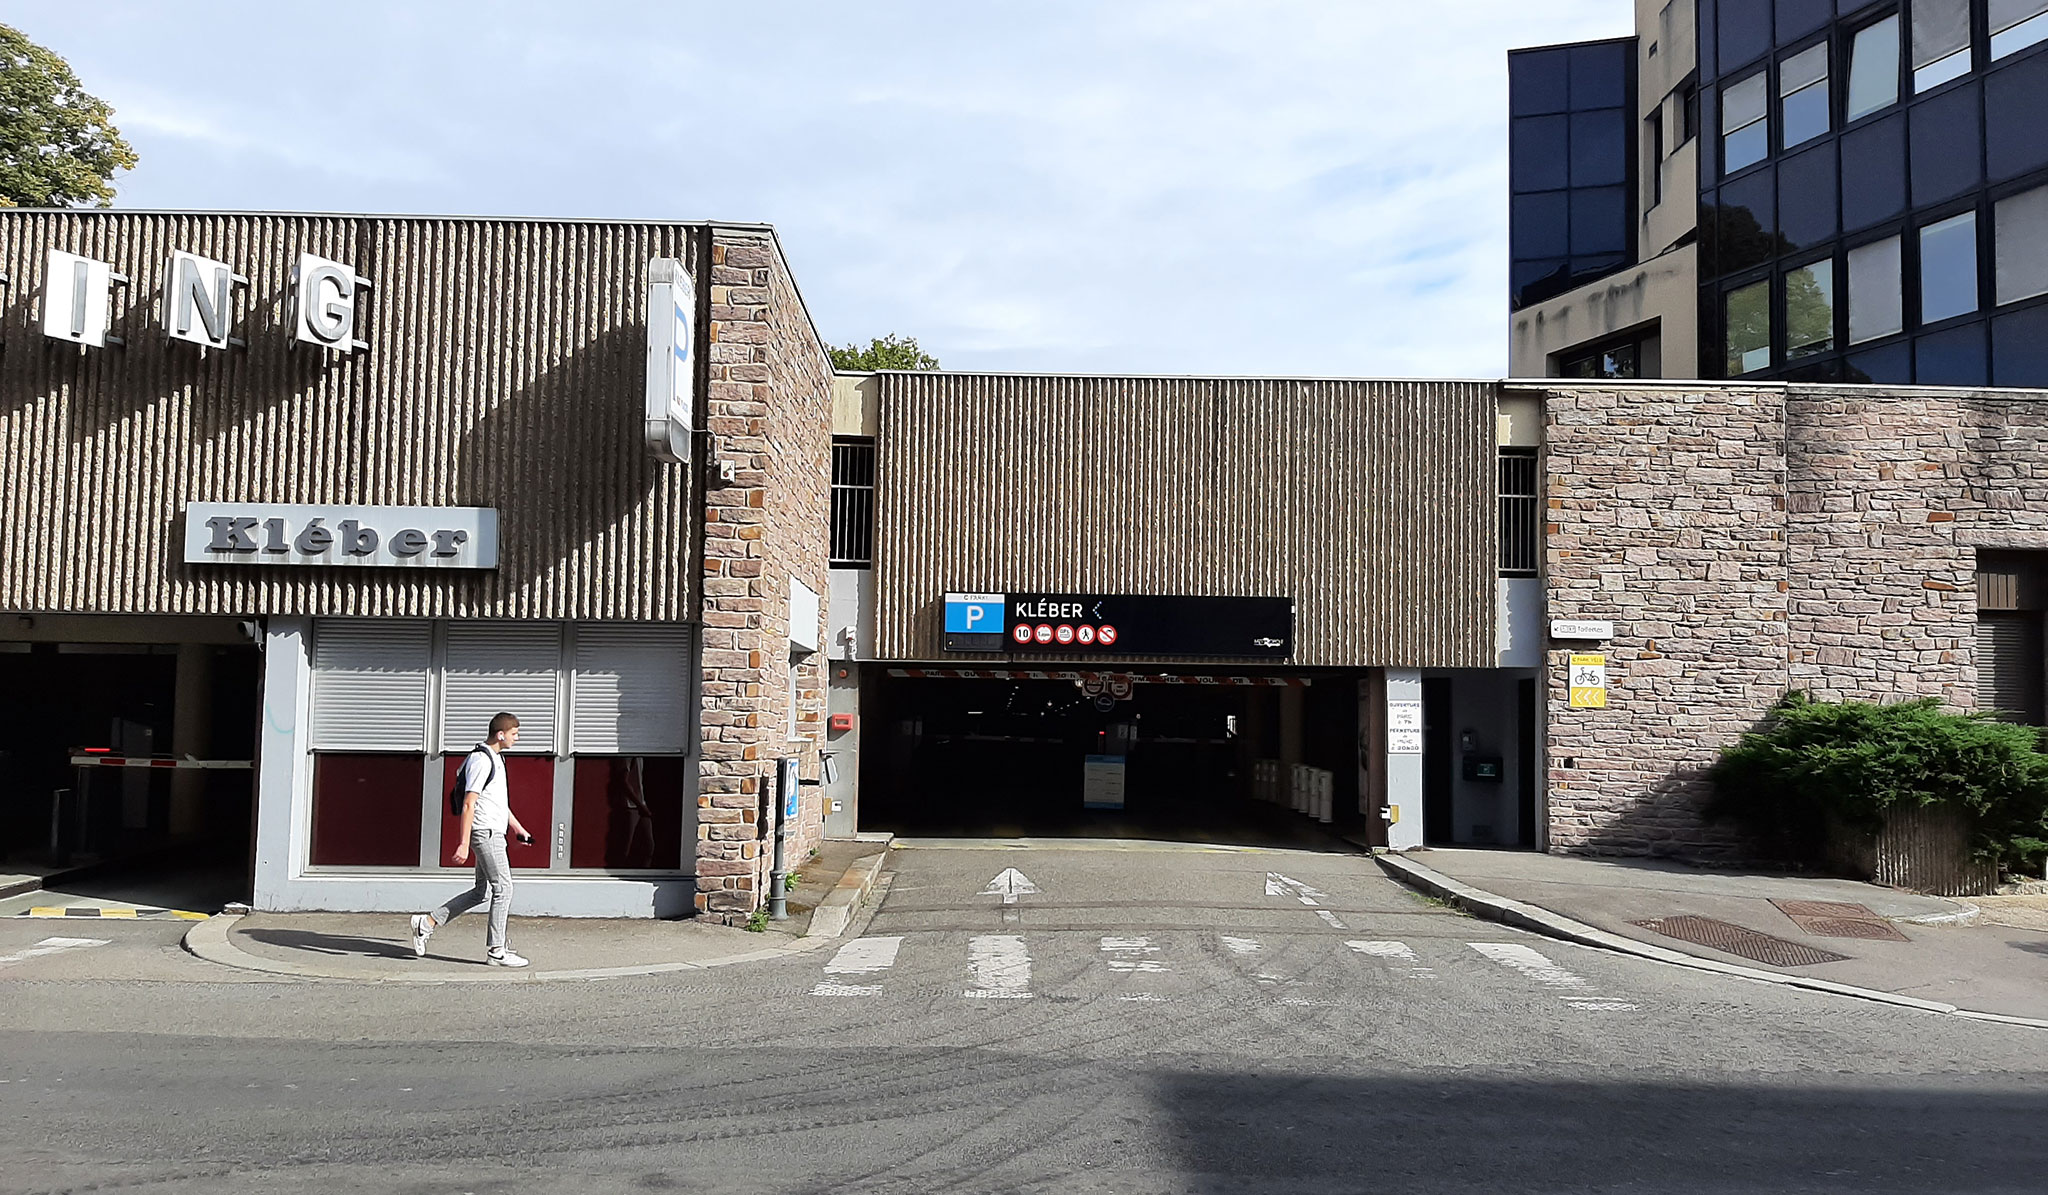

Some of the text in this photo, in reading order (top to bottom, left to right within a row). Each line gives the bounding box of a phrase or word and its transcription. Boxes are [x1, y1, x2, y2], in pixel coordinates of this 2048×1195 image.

[203, 516, 468, 557] Kléber
[967, 605, 984, 630] P
[1015, 597, 1083, 618] KLÉBER
[1018, 628, 1029, 638] 10
